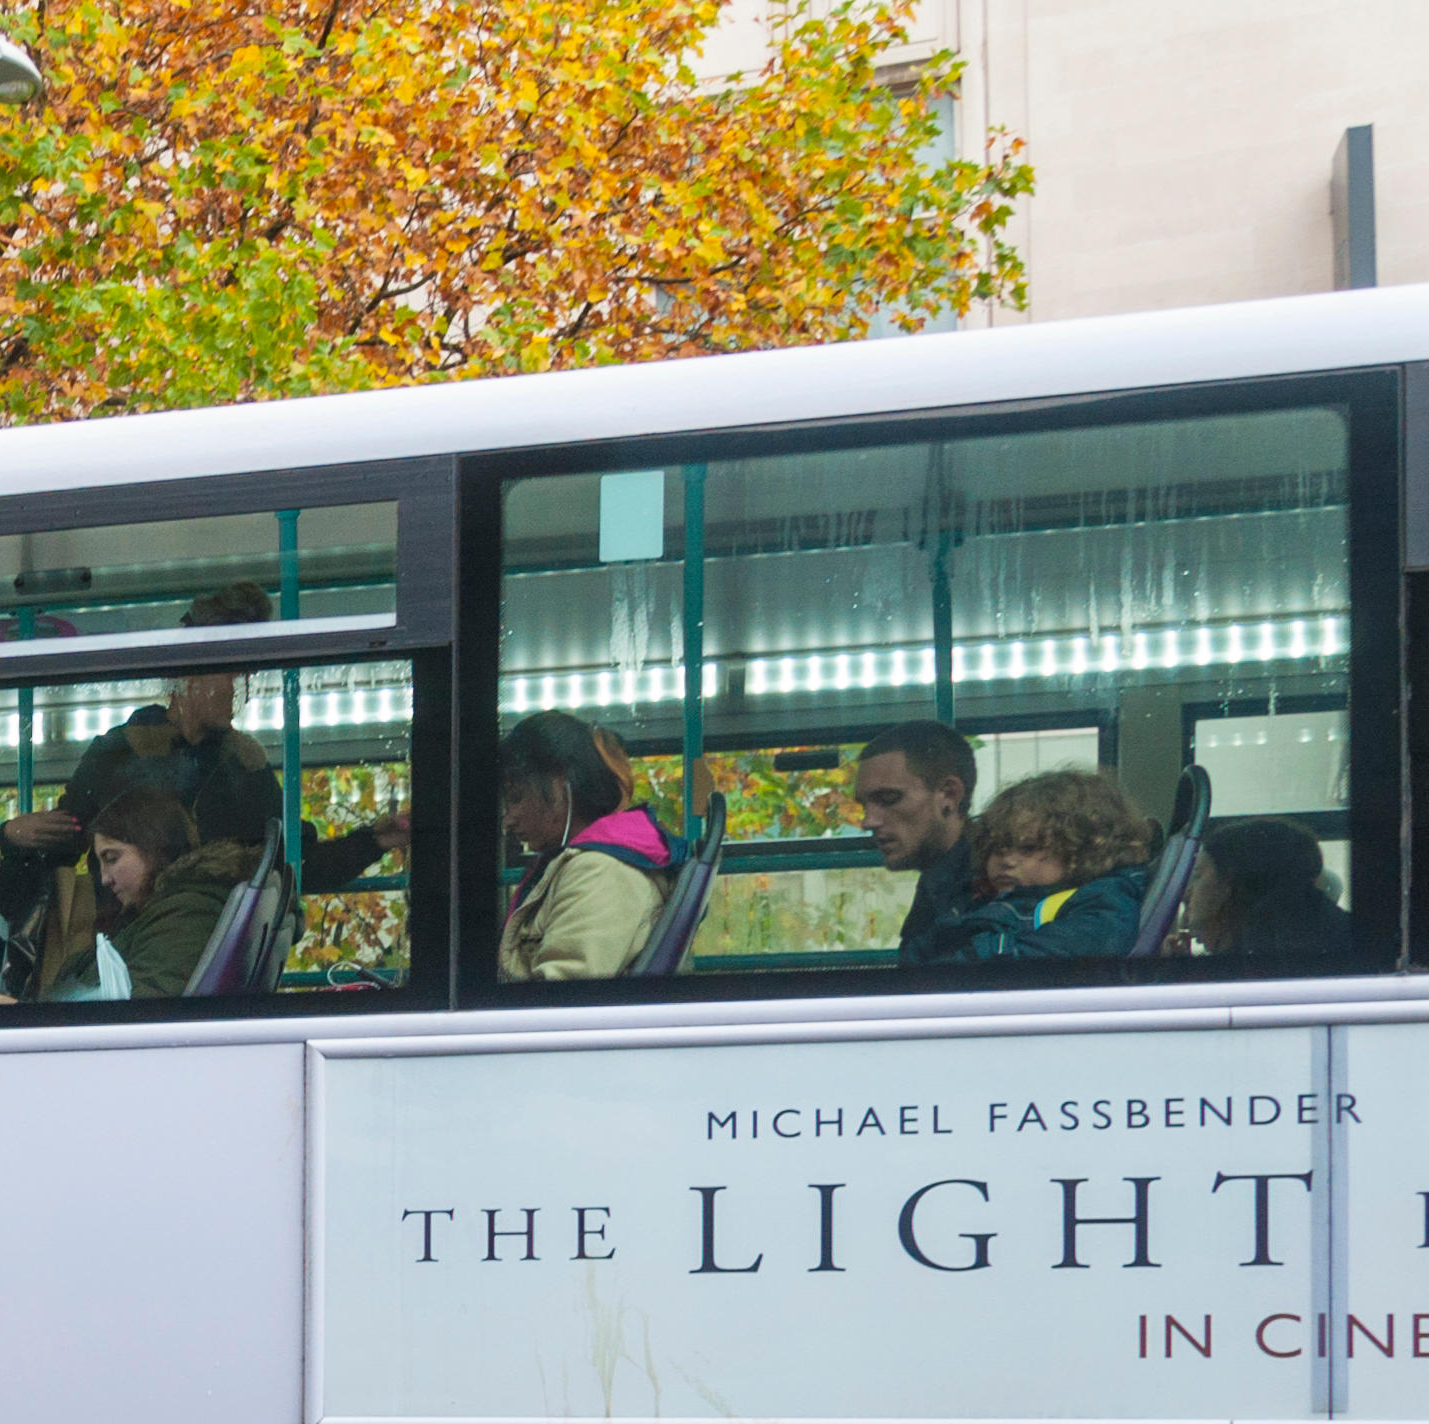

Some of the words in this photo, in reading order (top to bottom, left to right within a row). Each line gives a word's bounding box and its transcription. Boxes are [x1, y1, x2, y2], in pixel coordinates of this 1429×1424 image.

[705, 1104, 952, 1141] MICHAEL
[989, 1093, 1365, 1135] FASSBENDER
[401, 1206, 617, 1264] THE
[688, 1169, 1314, 1275] LIGHT
[1137, 1314, 1214, 1359] IN
